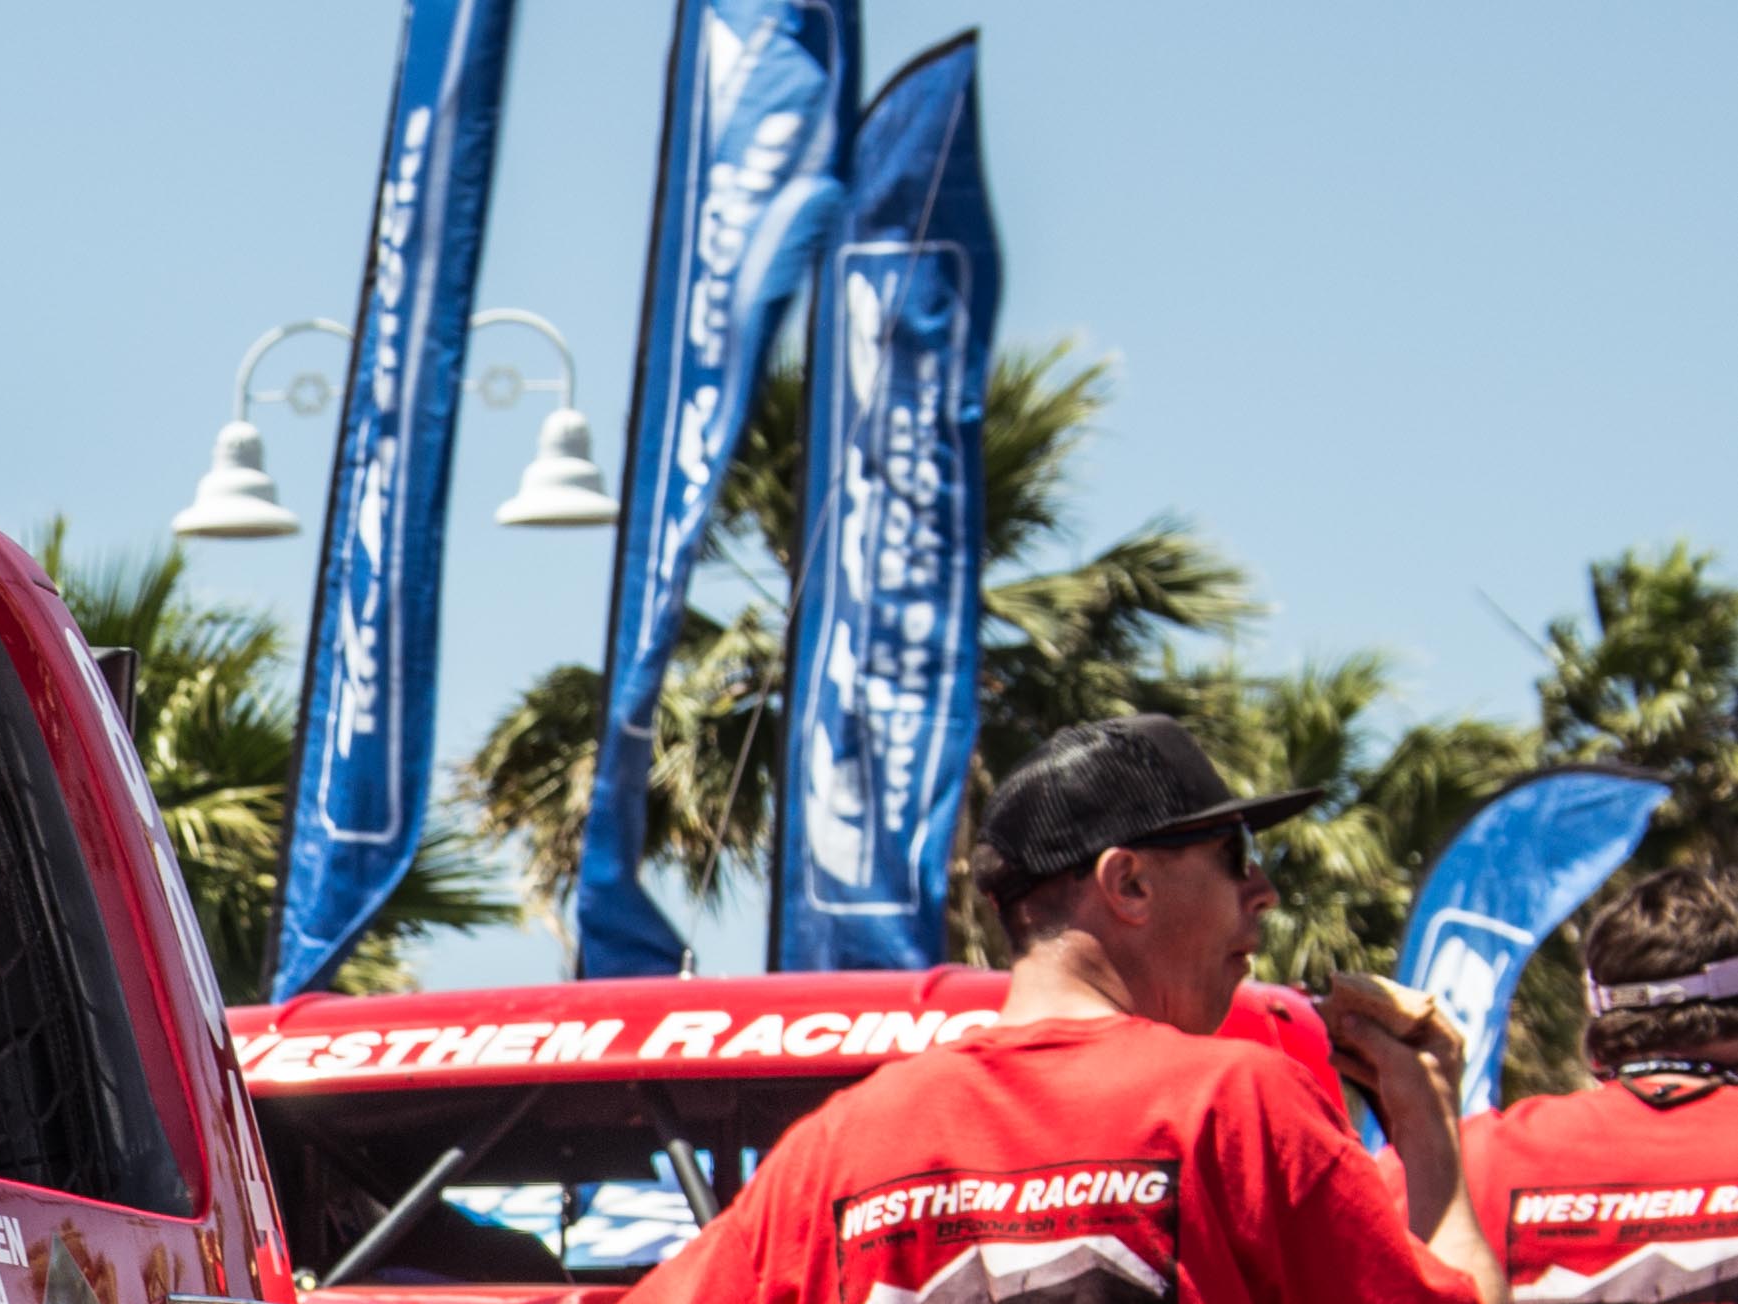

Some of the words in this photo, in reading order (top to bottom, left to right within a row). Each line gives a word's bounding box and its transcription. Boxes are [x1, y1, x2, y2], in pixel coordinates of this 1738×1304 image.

[841, 1178, 1016, 1241] WESTHEM
[1016, 1169, 1169, 1213] RACING
[1514, 1188, 1704, 1224] WESTHEM
